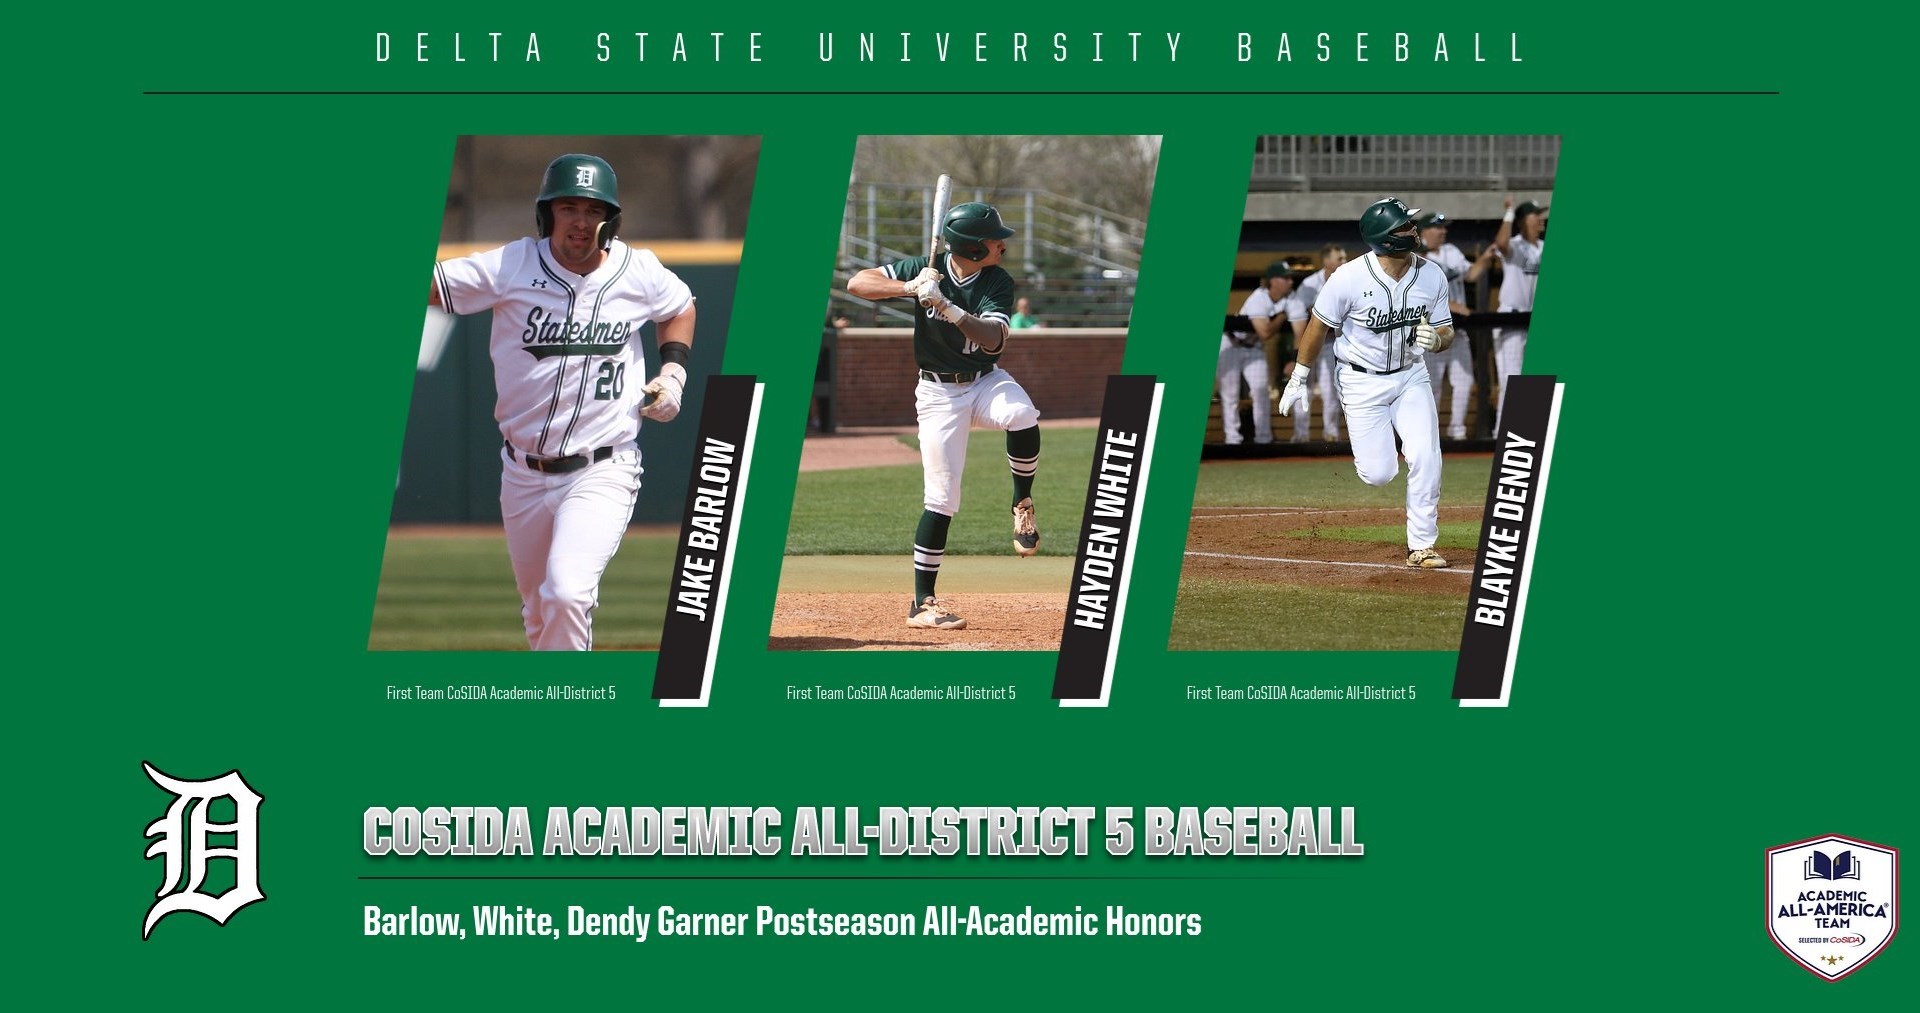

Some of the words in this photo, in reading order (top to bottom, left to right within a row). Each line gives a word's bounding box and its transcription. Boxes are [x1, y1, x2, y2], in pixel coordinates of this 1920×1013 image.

[522, 306, 631, 344] Statesmen
[1366, 304, 1428, 327] Statesmen
[594, 362, 625, 400] 20
